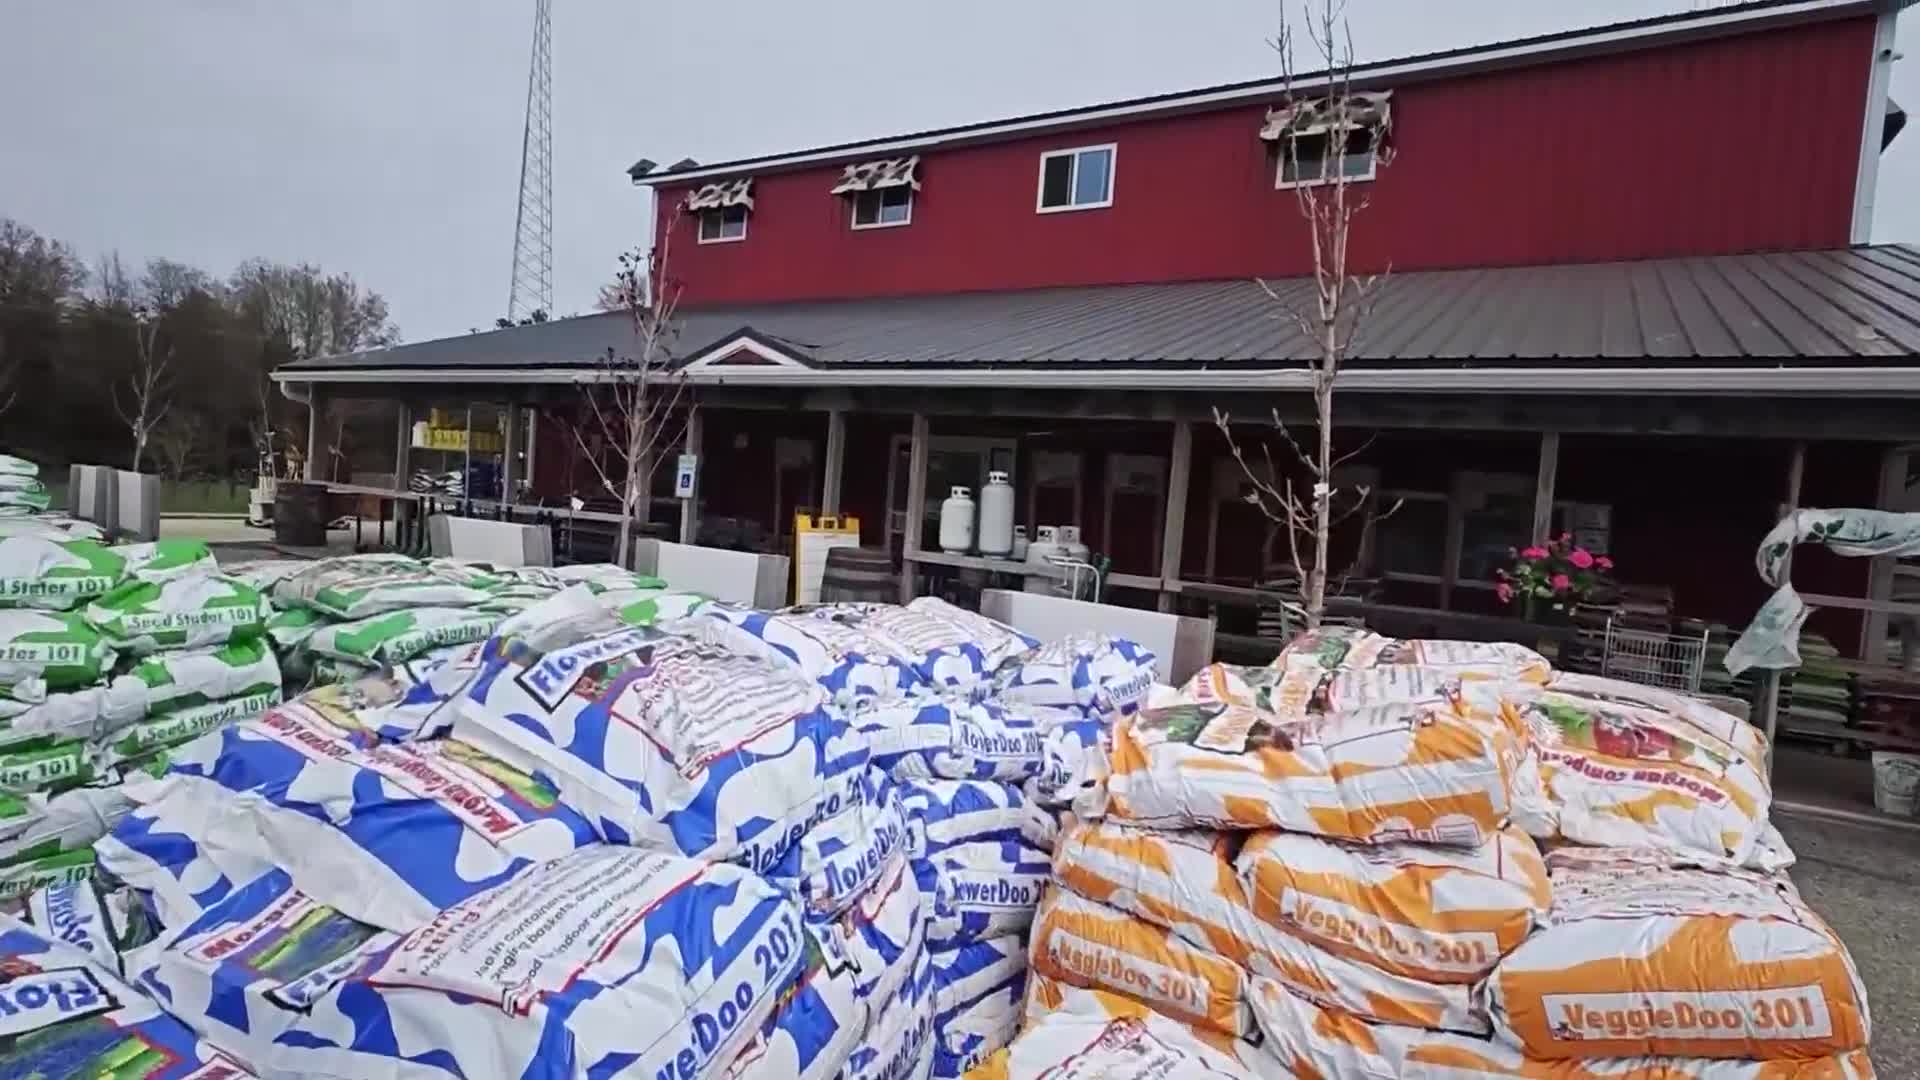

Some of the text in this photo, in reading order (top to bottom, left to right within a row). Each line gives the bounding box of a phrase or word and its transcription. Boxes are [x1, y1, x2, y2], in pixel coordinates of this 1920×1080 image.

[76, 578, 106, 594] 101
[228, 609, 251, 621] 101
[47, 644, 80, 660] 101
[243, 697, 266, 714] 101
[38, 758, 71, 778] 101
[65, 865, 96, 883] 101
[754, 912, 798, 986] 201
[1432, 938, 1487, 964] 301
[1158, 975, 1198, 1007] 301
[1560, 996, 1815, 1036] VeggieDoo 301
